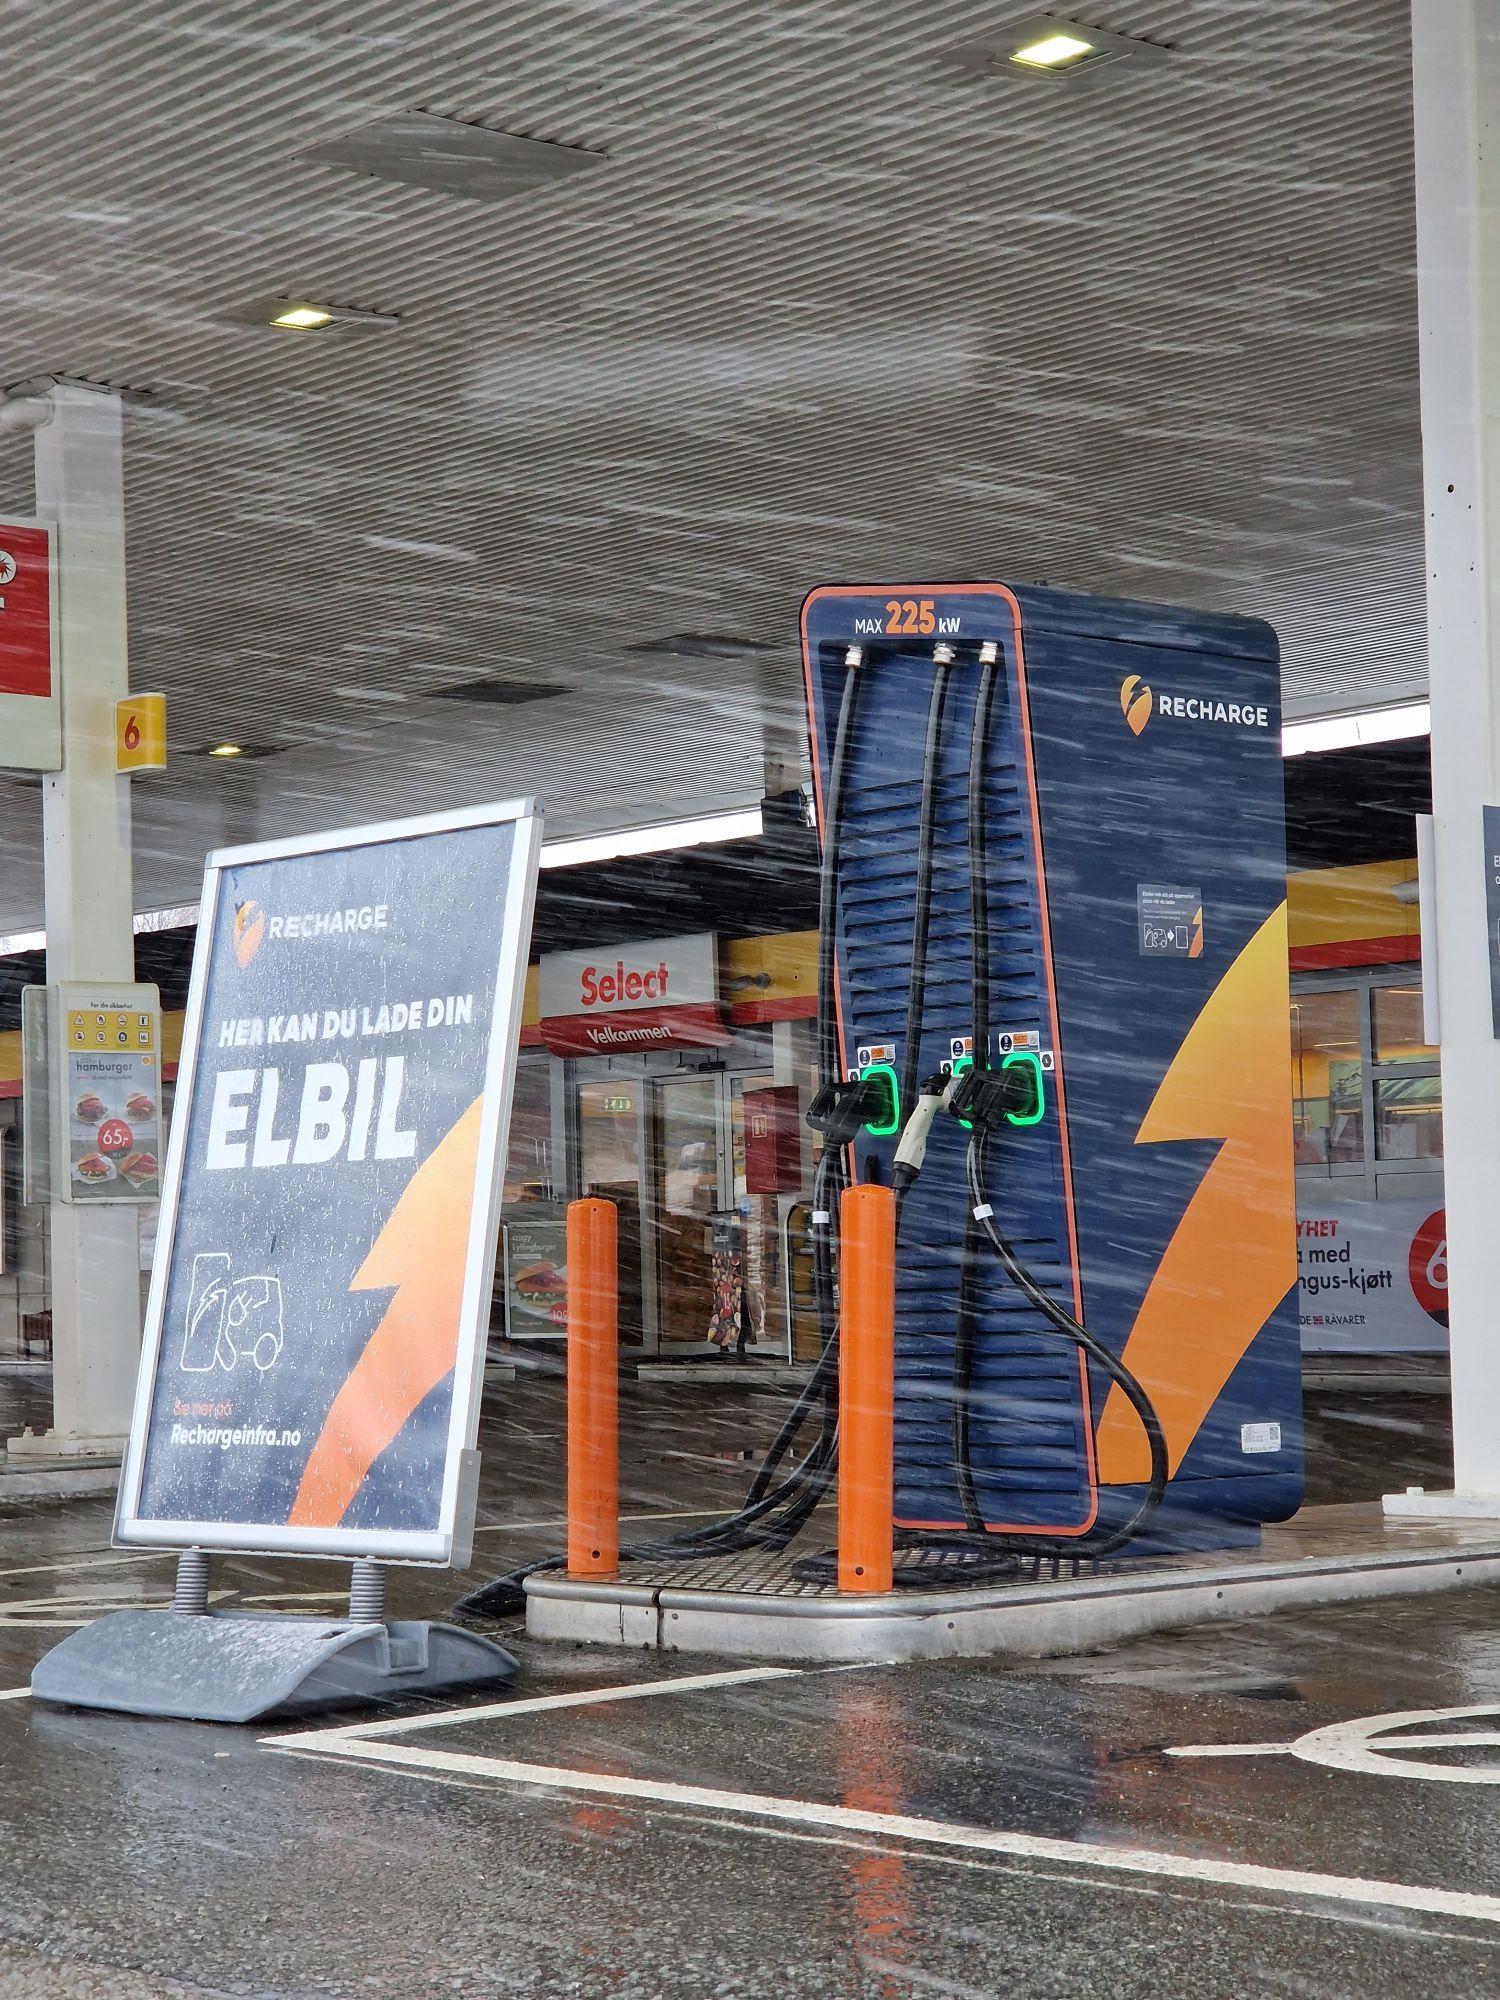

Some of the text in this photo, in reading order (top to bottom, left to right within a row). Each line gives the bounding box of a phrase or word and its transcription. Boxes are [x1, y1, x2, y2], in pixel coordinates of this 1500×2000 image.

[855, 600, 961, 634] MAX 225 kW
[1159, 695, 1269, 727] RECHARGE
[124, 715, 141, 750] 6
[268, 904, 389, 940] RECHARGE
[581, 961, 669, 1006] Select
[218, 993, 474, 1048] HER KAN DU LADE DIN
[586, 1025, 673, 1044] Velkommen
[76, 1059, 133, 1073] hamburger
[205, 1055, 418, 1170] ELBIL
[102, 1128, 129, 1147] 65,-
[511, 1233, 532, 1243] crispy
[1309, 1241, 1351, 1263] med
[1325, 1312, 1366, 1325] RÅVARER
[170, 1423, 301, 1450] Rechargeinfra.no
